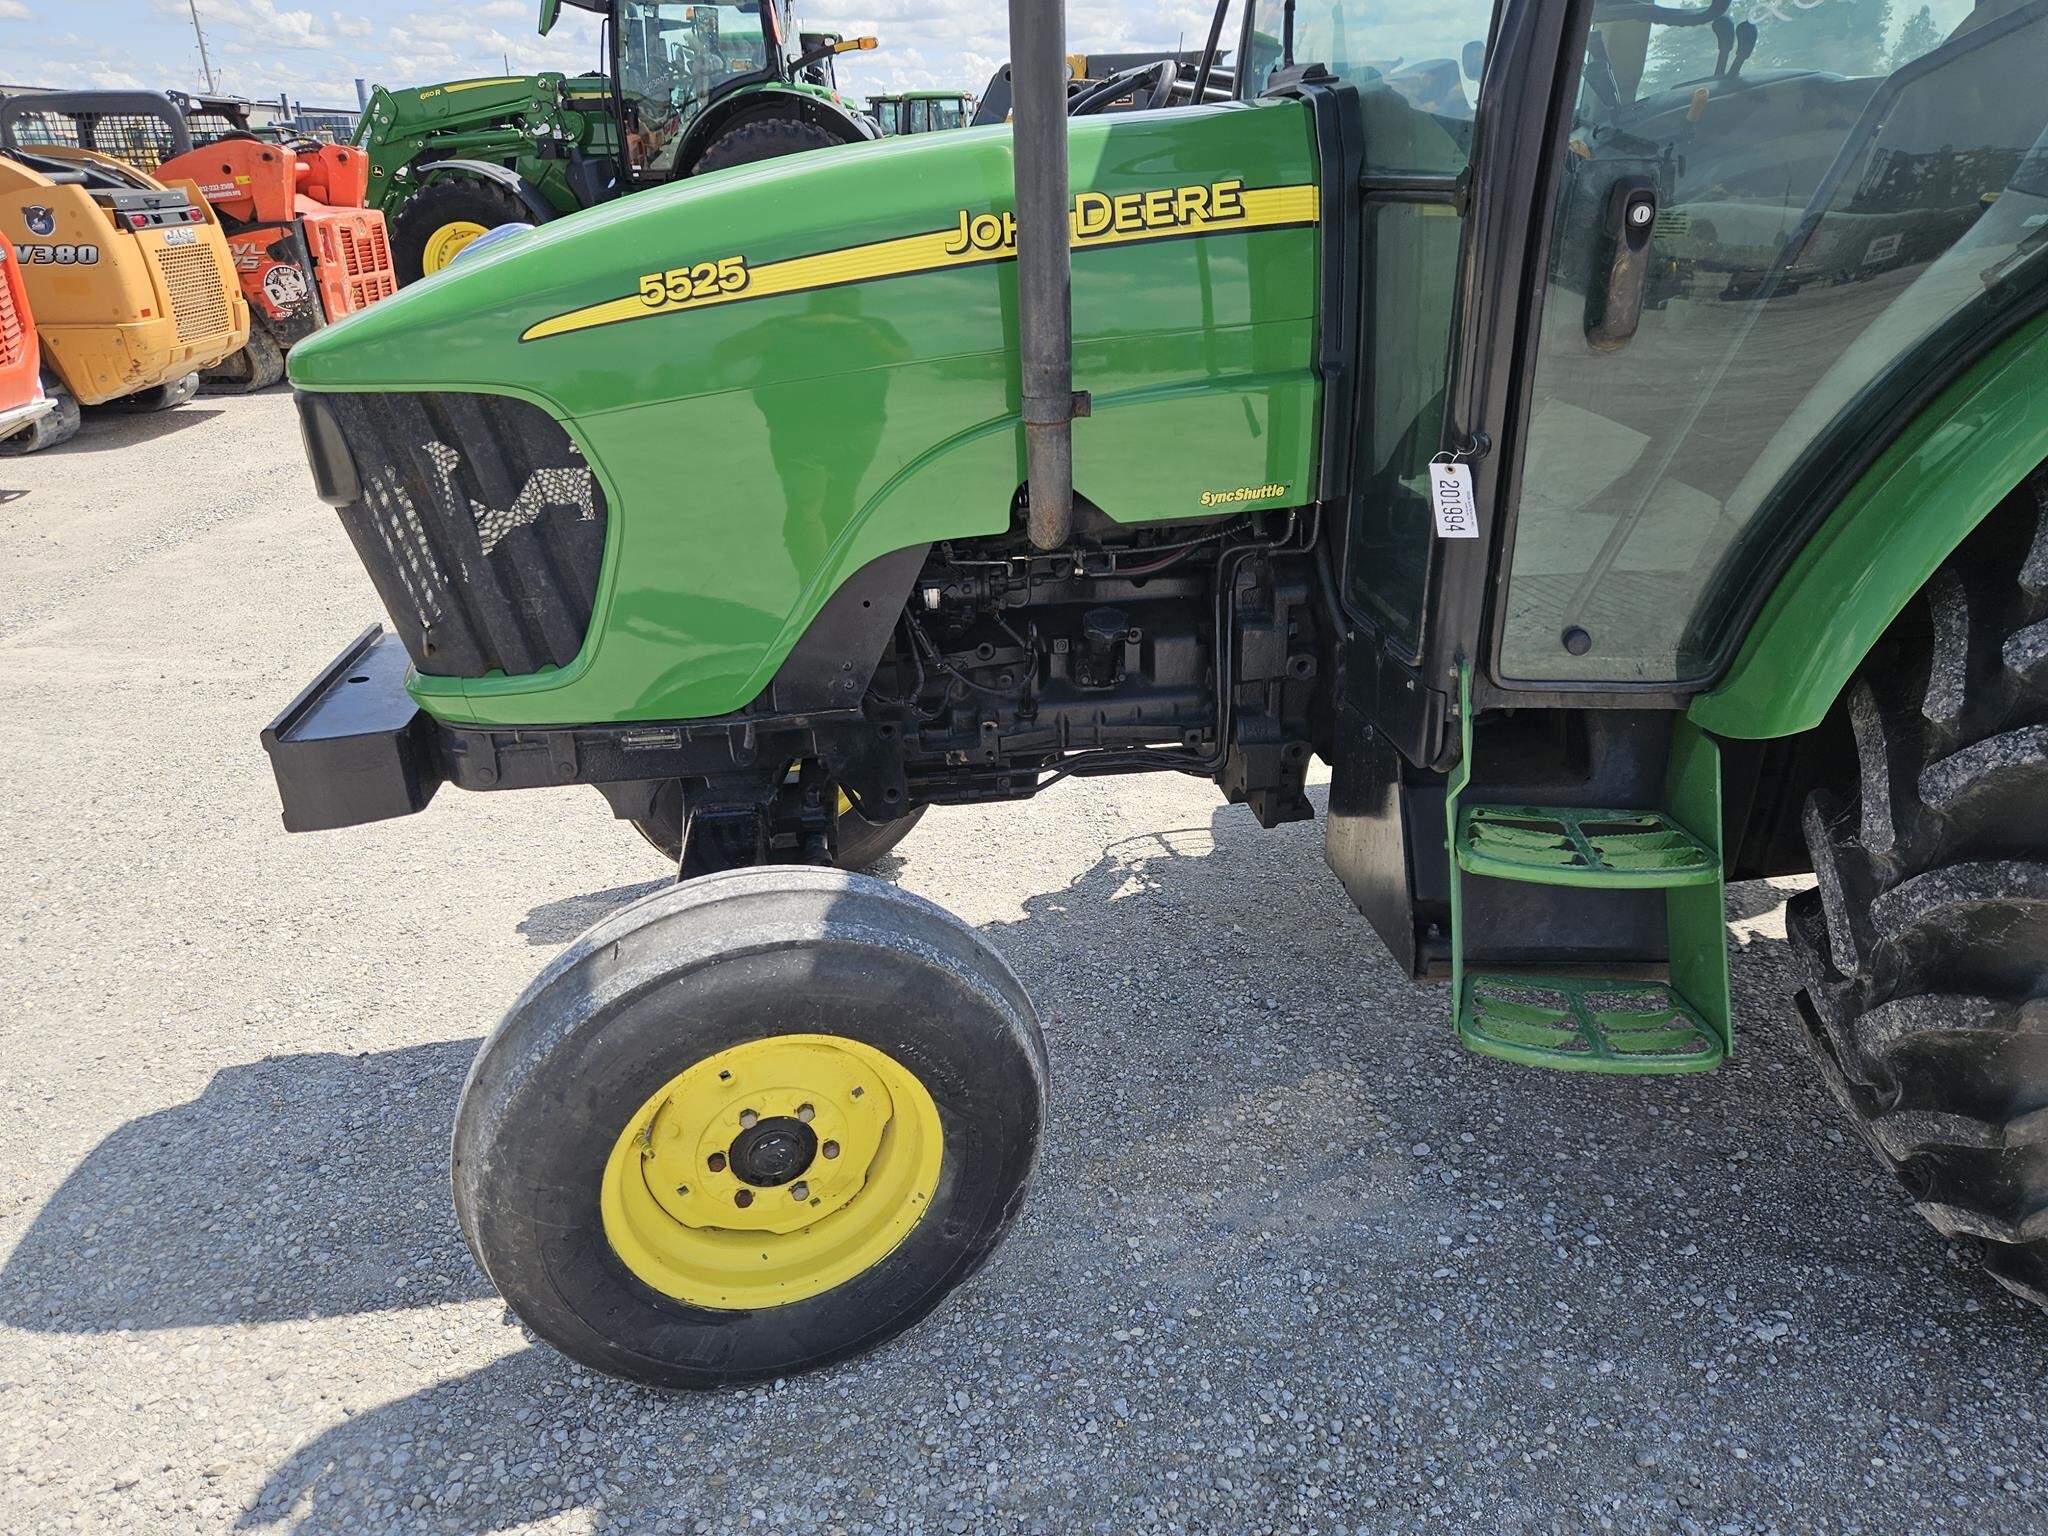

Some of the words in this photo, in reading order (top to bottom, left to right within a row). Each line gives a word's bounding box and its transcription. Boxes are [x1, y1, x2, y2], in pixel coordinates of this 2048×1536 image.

[1075, 179, 1245, 238] DEERE
[163, 227, 197, 245] CASE
[640, 255, 750, 308] 5525
[1200, 483, 1286, 507] SyncShuttle
[1440, 480, 1466, 532] 201994
